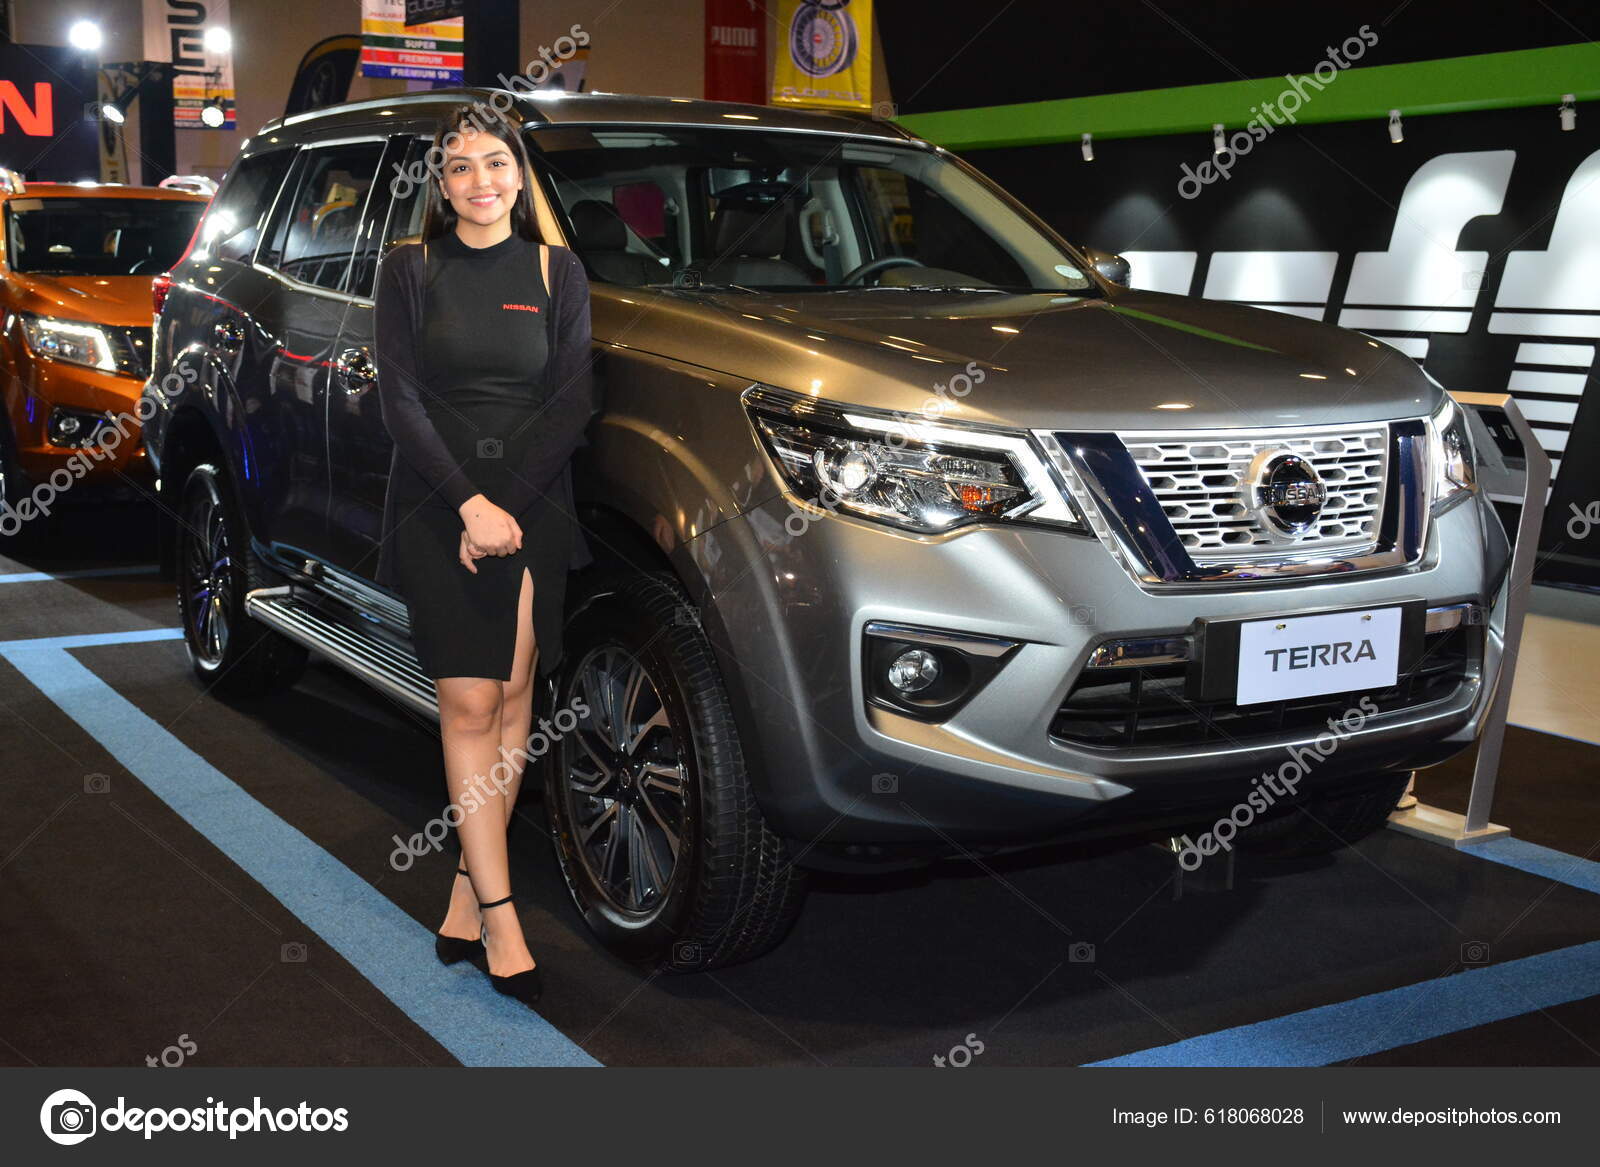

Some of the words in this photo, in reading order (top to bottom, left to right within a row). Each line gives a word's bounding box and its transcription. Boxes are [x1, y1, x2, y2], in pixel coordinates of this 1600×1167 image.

[404, 40, 437, 50] SUPER
[398, 54, 443, 65] PREMIUM
[390, 68, 436, 78] PREMIUM
[502, 303, 540, 313] NISSAN
[1264, 639, 1377, 672] TERRA
